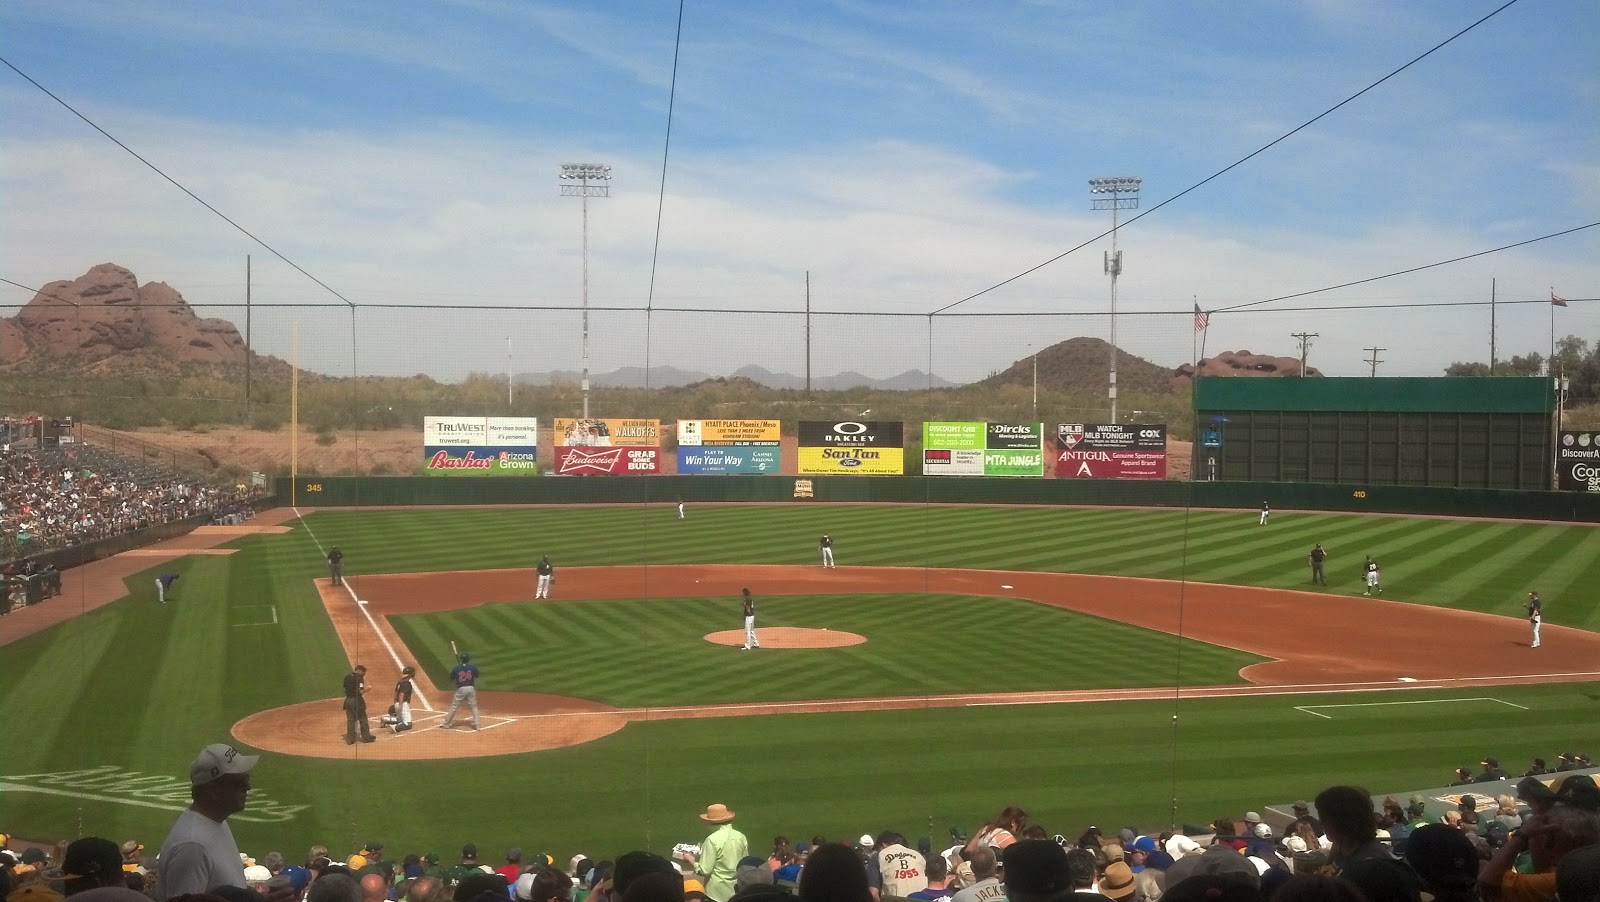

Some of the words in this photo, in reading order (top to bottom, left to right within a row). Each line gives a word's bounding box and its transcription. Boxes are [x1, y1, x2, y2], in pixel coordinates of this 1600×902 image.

[1140, 430, 1160, 438] COX
[822, 448, 850, 458] San
[852, 449, 879, 458] Tan
[1058, 451, 1111, 461] ANTIGUA
[500, 460, 533, 468] Grown
[561, 455, 619, 464] Budweiser
[686, 456, 702, 464] Win
[704, 456, 722, 464] Your
[724, 456, 742, 466] Way
[985, 455, 1006, 465] PITA
[1008, 455, 1041, 466] JUNGLE
[884, 852, 916, 864] Dodgers
[900, 860, 908, 870] B
[894, 868, 919, 879] 1955
